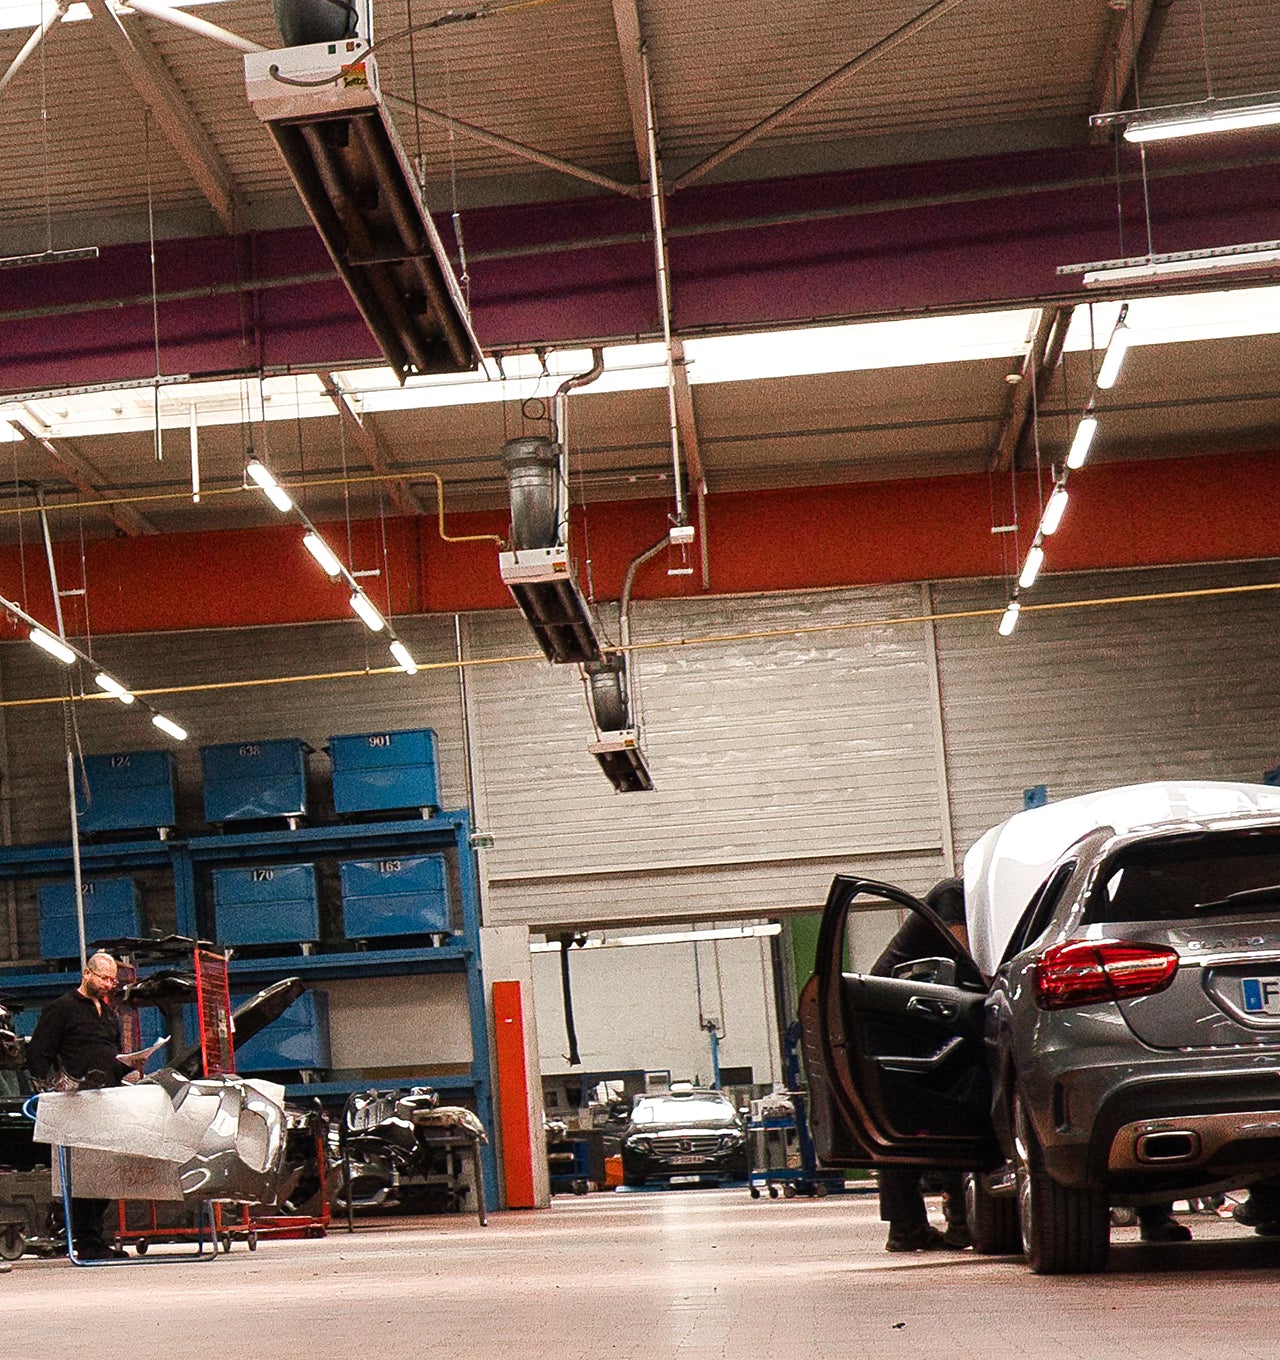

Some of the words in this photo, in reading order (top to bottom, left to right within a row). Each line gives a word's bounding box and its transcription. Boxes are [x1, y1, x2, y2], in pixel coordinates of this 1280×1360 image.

[369, 735, 391, 748] 901
[239, 745, 261, 757] 638
[380, 861, 401, 873] 163
[253, 870, 274, 881] 170
[81, 883, 94, 895] 21
